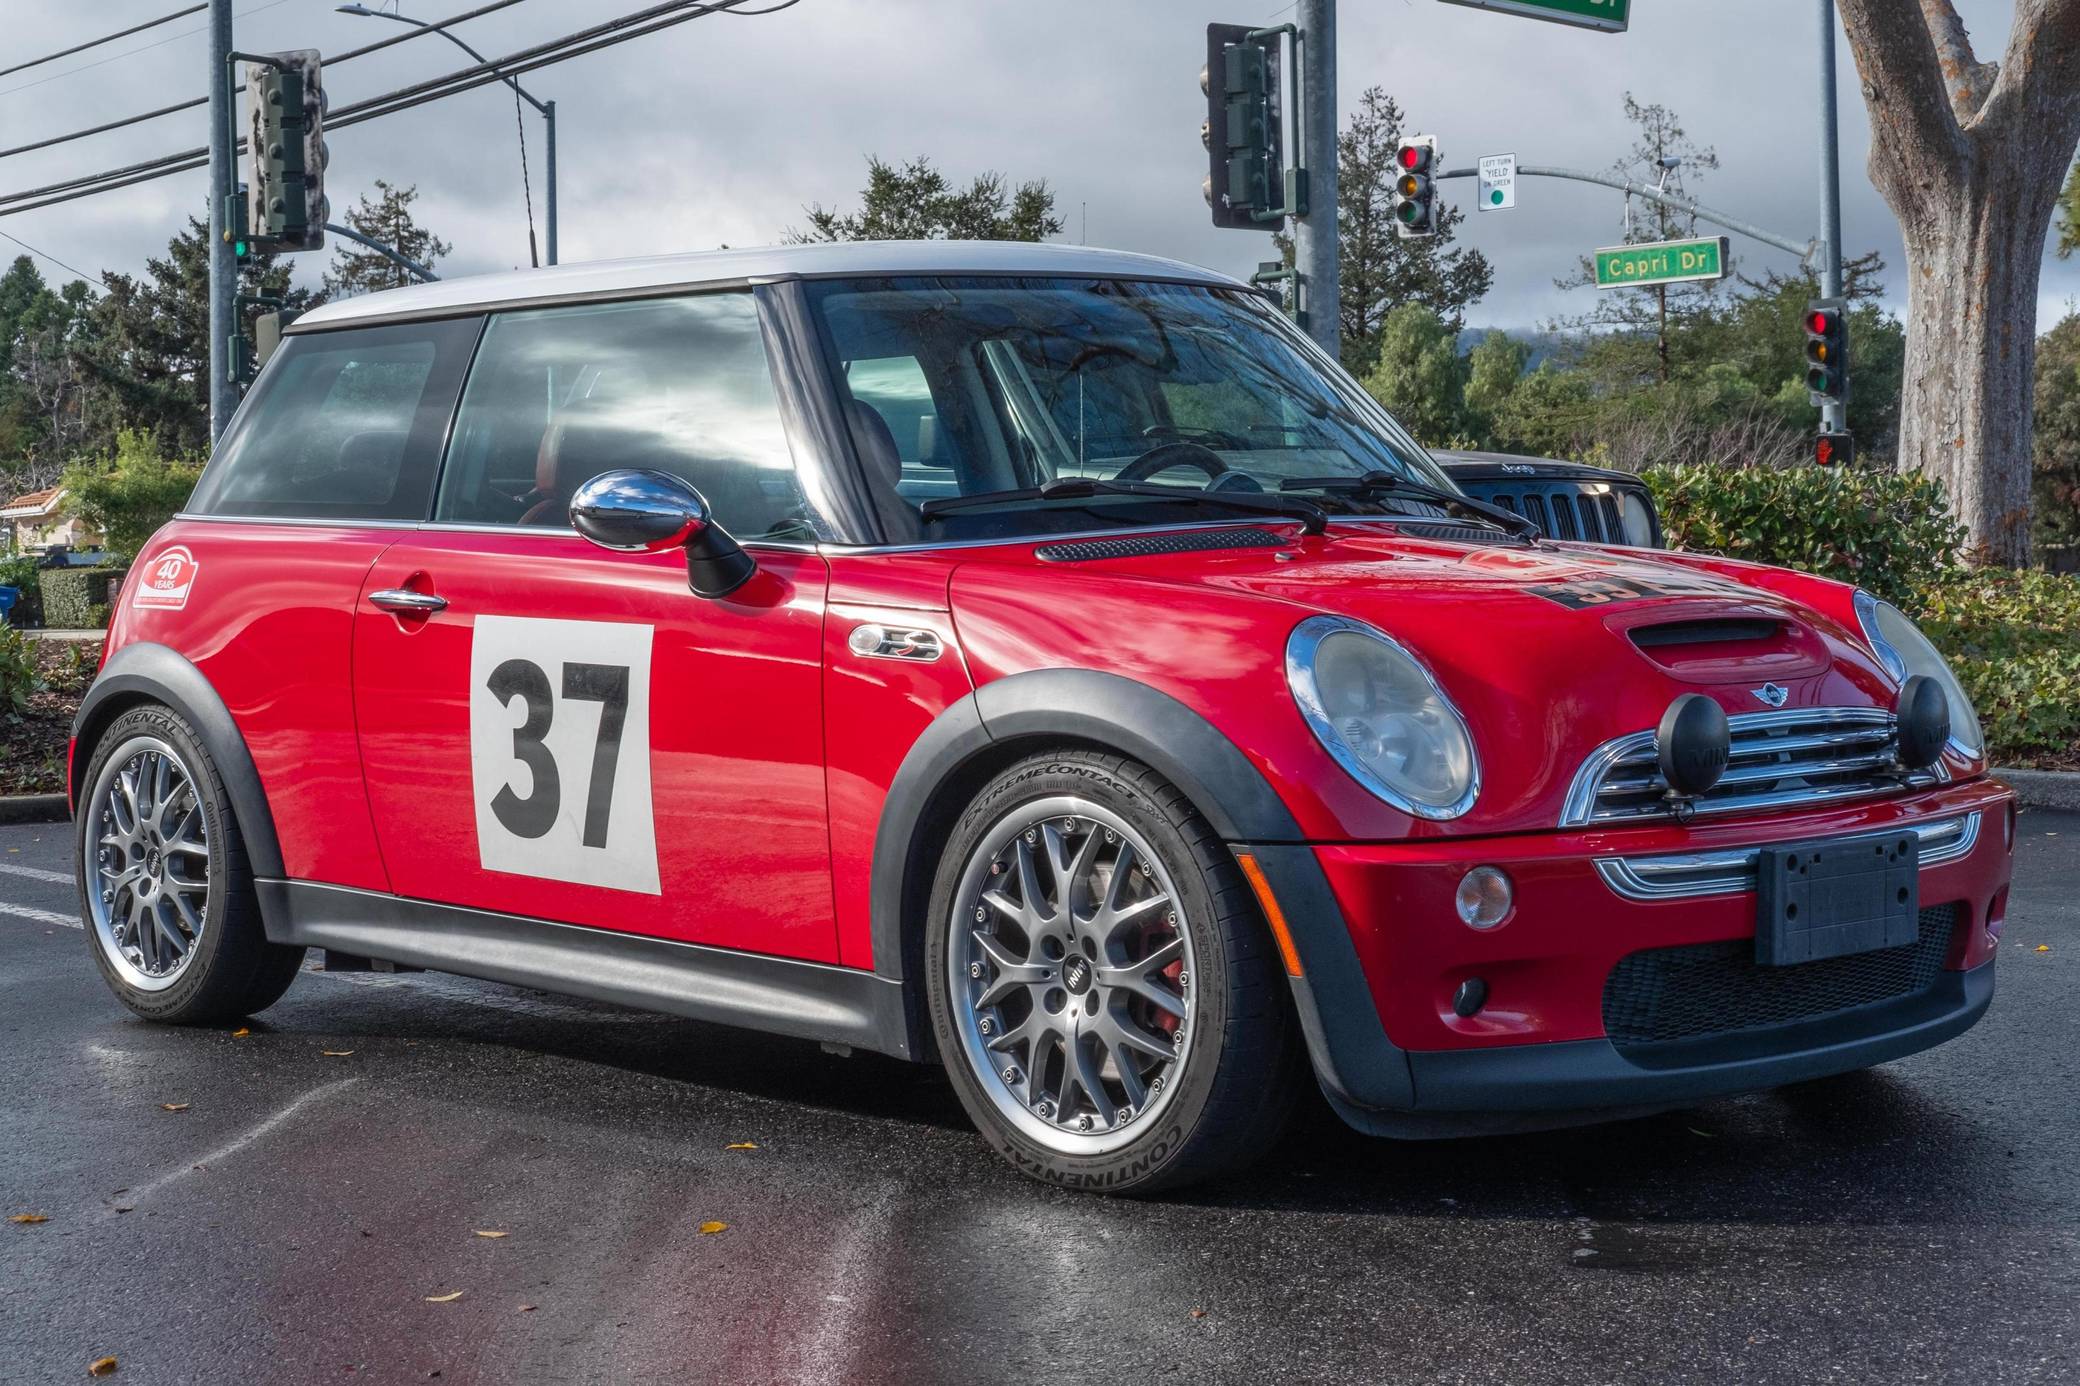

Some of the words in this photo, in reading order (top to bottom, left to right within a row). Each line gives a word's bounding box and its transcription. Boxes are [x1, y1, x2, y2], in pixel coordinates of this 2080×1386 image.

[1609, 254, 1668, 277] Capri
[1681, 251, 1706, 270] Dr
[156, 559, 182, 580] 40
[154, 579, 176, 589] YEARS
[486, 658, 630, 849] 37
[1067, 959, 1087, 989] MINI
[1002, 1125, 1183, 1188] CONTINENTAL
